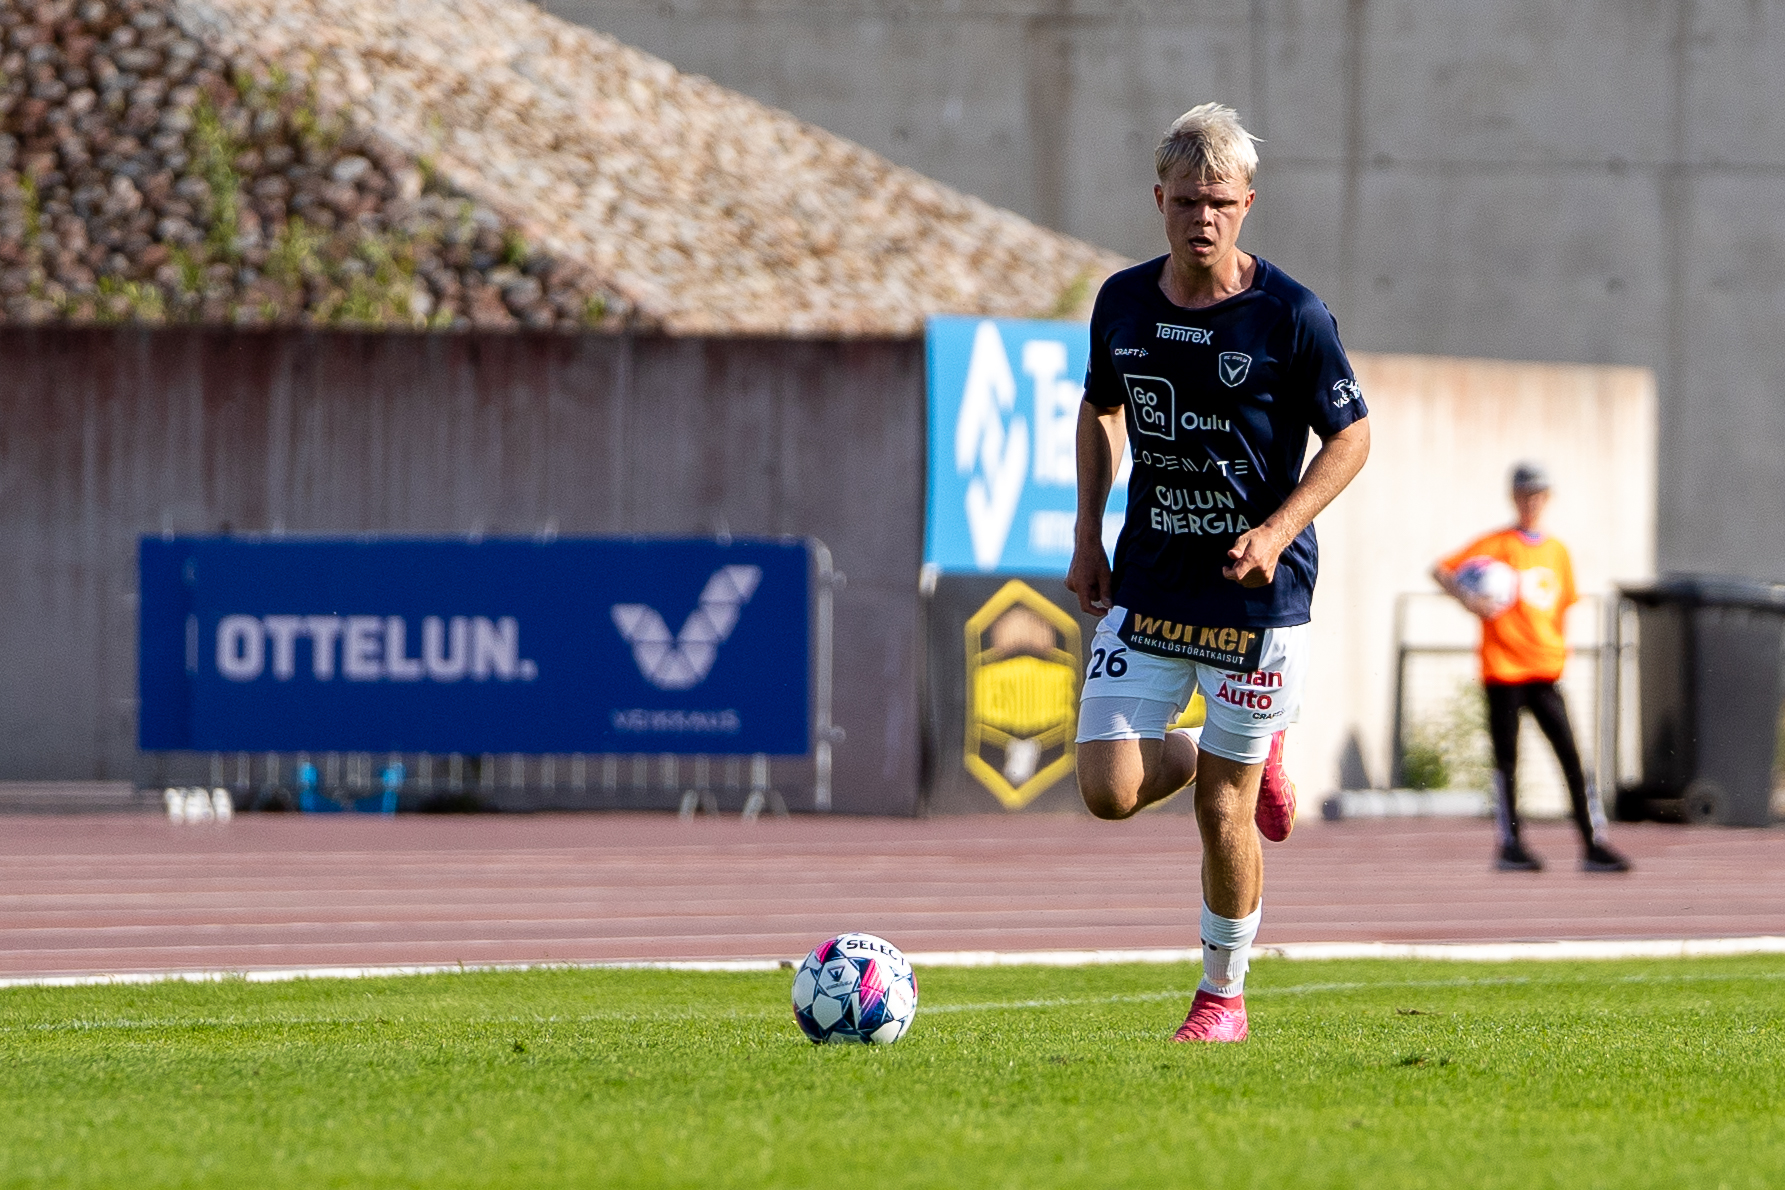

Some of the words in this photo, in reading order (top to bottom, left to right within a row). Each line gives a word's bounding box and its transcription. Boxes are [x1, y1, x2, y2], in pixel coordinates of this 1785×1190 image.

[1114, 348, 1140, 356] CRAFT
[1133, 386, 1158, 406] Go
[1181, 411, 1231, 432] Oulu
[1156, 486, 1236, 510] OULUN
[1151, 507, 1251, 535] ENERGIA
[216, 614, 537, 681] OTTELUN.
[1130, 634, 1245, 665] HENKILÖSTÖRATKAISUT
[1088, 647, 1128, 680] 26
[1215, 680, 1273, 710] Auto
